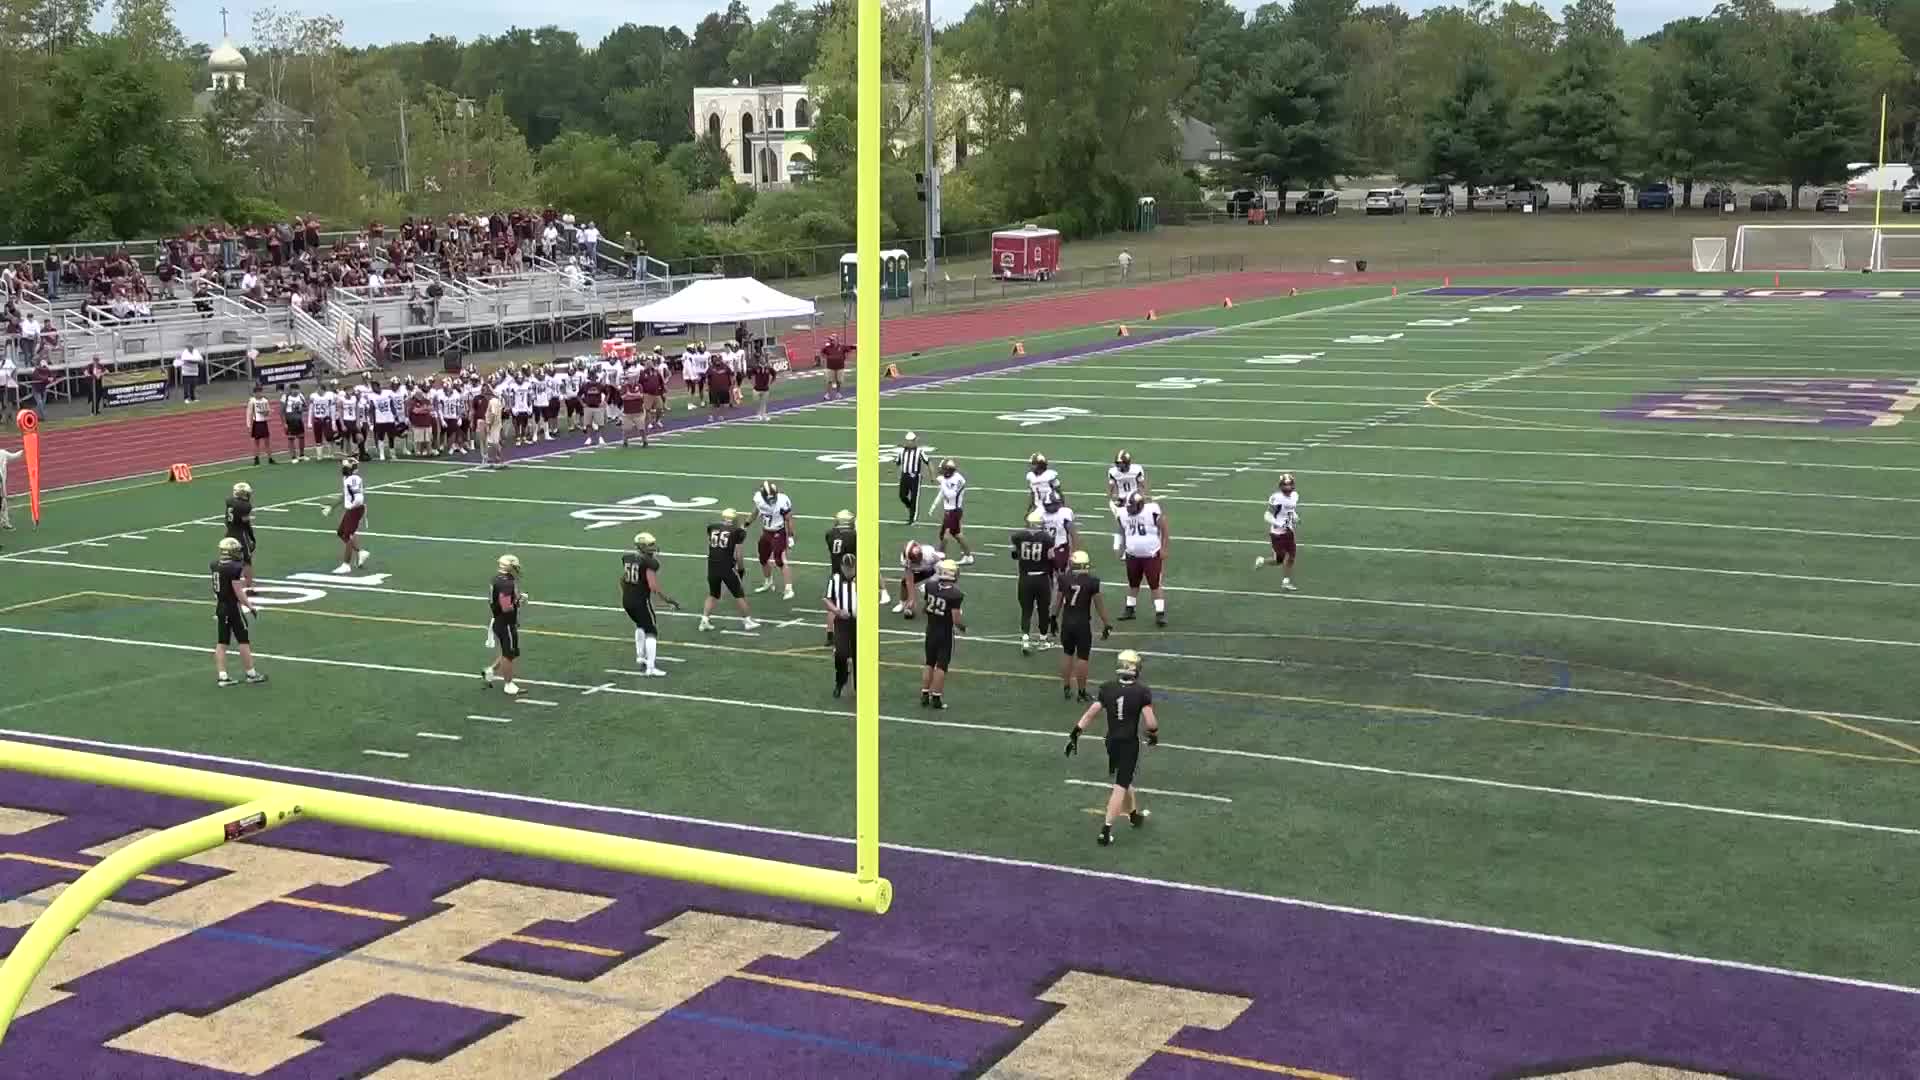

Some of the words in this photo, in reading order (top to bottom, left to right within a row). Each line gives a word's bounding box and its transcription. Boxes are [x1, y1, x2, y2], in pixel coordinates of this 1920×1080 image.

[227, 507, 234, 523] 5
[710, 529, 730, 549] 55
[1021, 541, 1043, 562] 68
[212, 571, 221, 594] 9
[926, 594, 946, 617] 22
[1070, 585, 1081, 607] 7
[1115, 695, 1125, 721] 1
